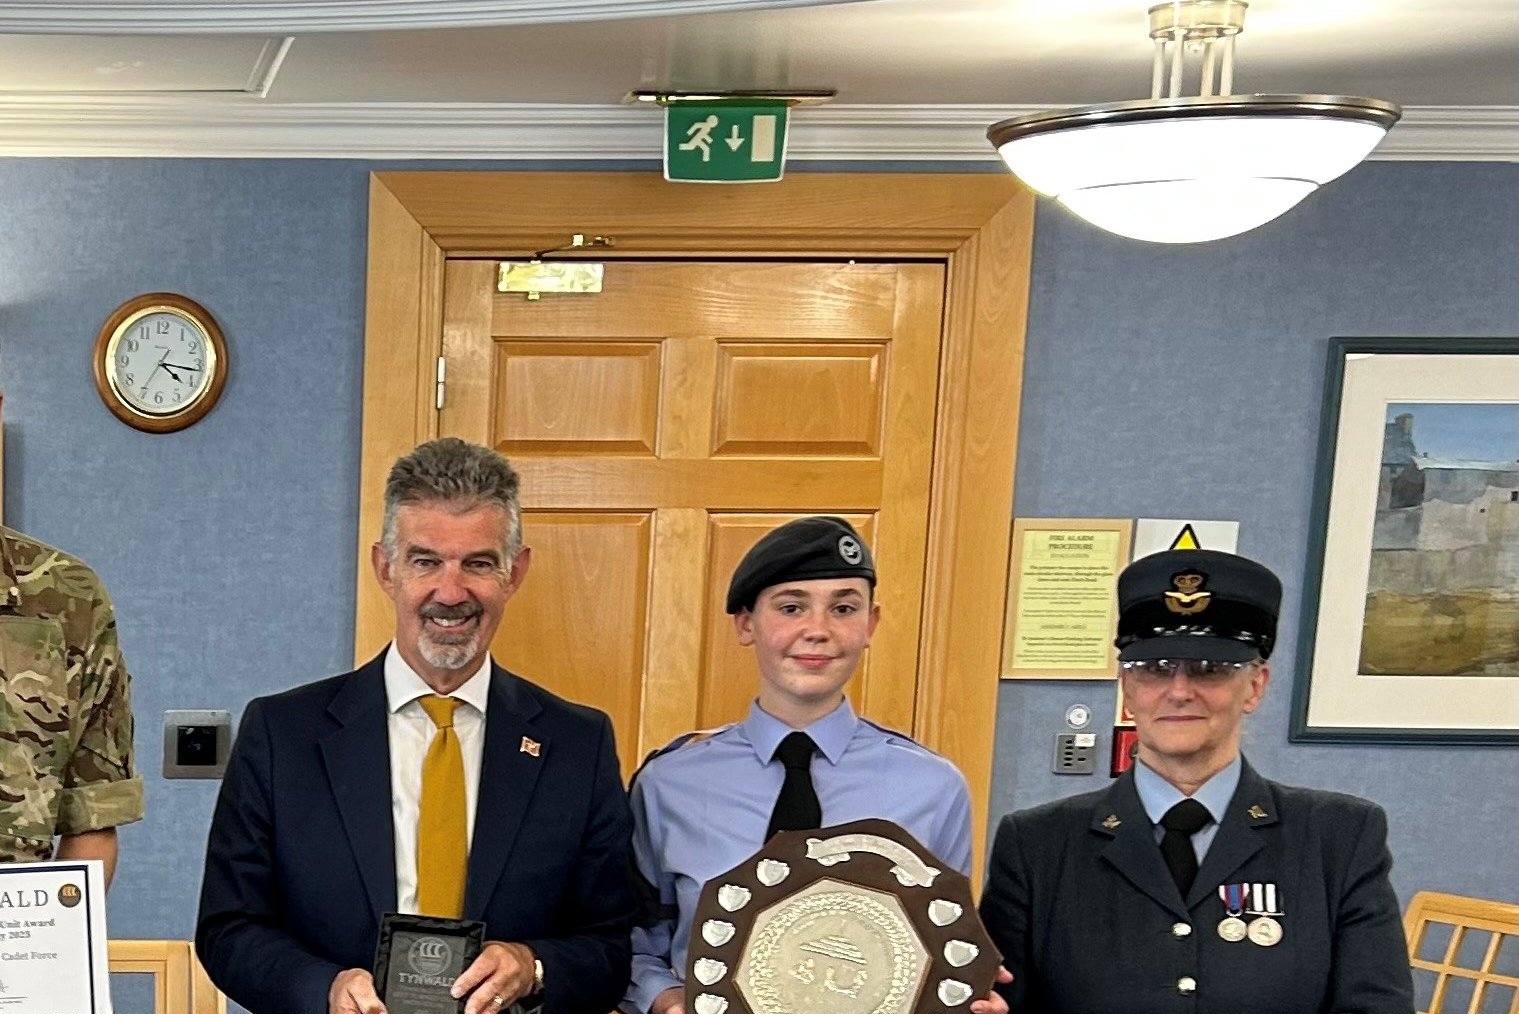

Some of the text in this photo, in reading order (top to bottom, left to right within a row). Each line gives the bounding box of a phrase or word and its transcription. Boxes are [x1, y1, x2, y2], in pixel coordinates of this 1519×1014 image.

[140, 326, 150, 340] 11
[156, 321, 170, 335] 12
[127, 340, 139, 353] 10
[188, 342, 197, 355] 2
[121, 355, 130, 368] 9
[125, 373, 134, 386] 8
[140, 386, 148, 399] 7
[154, 391, 163, 404] 6
[0, 919, 21, 929] Unit
[23, 918, 56, 928] Award
[1, 952, 29, 962] Cadet
[30, 951, 58, 960] Force
[399, 972, 455, 986] TYNWALD
